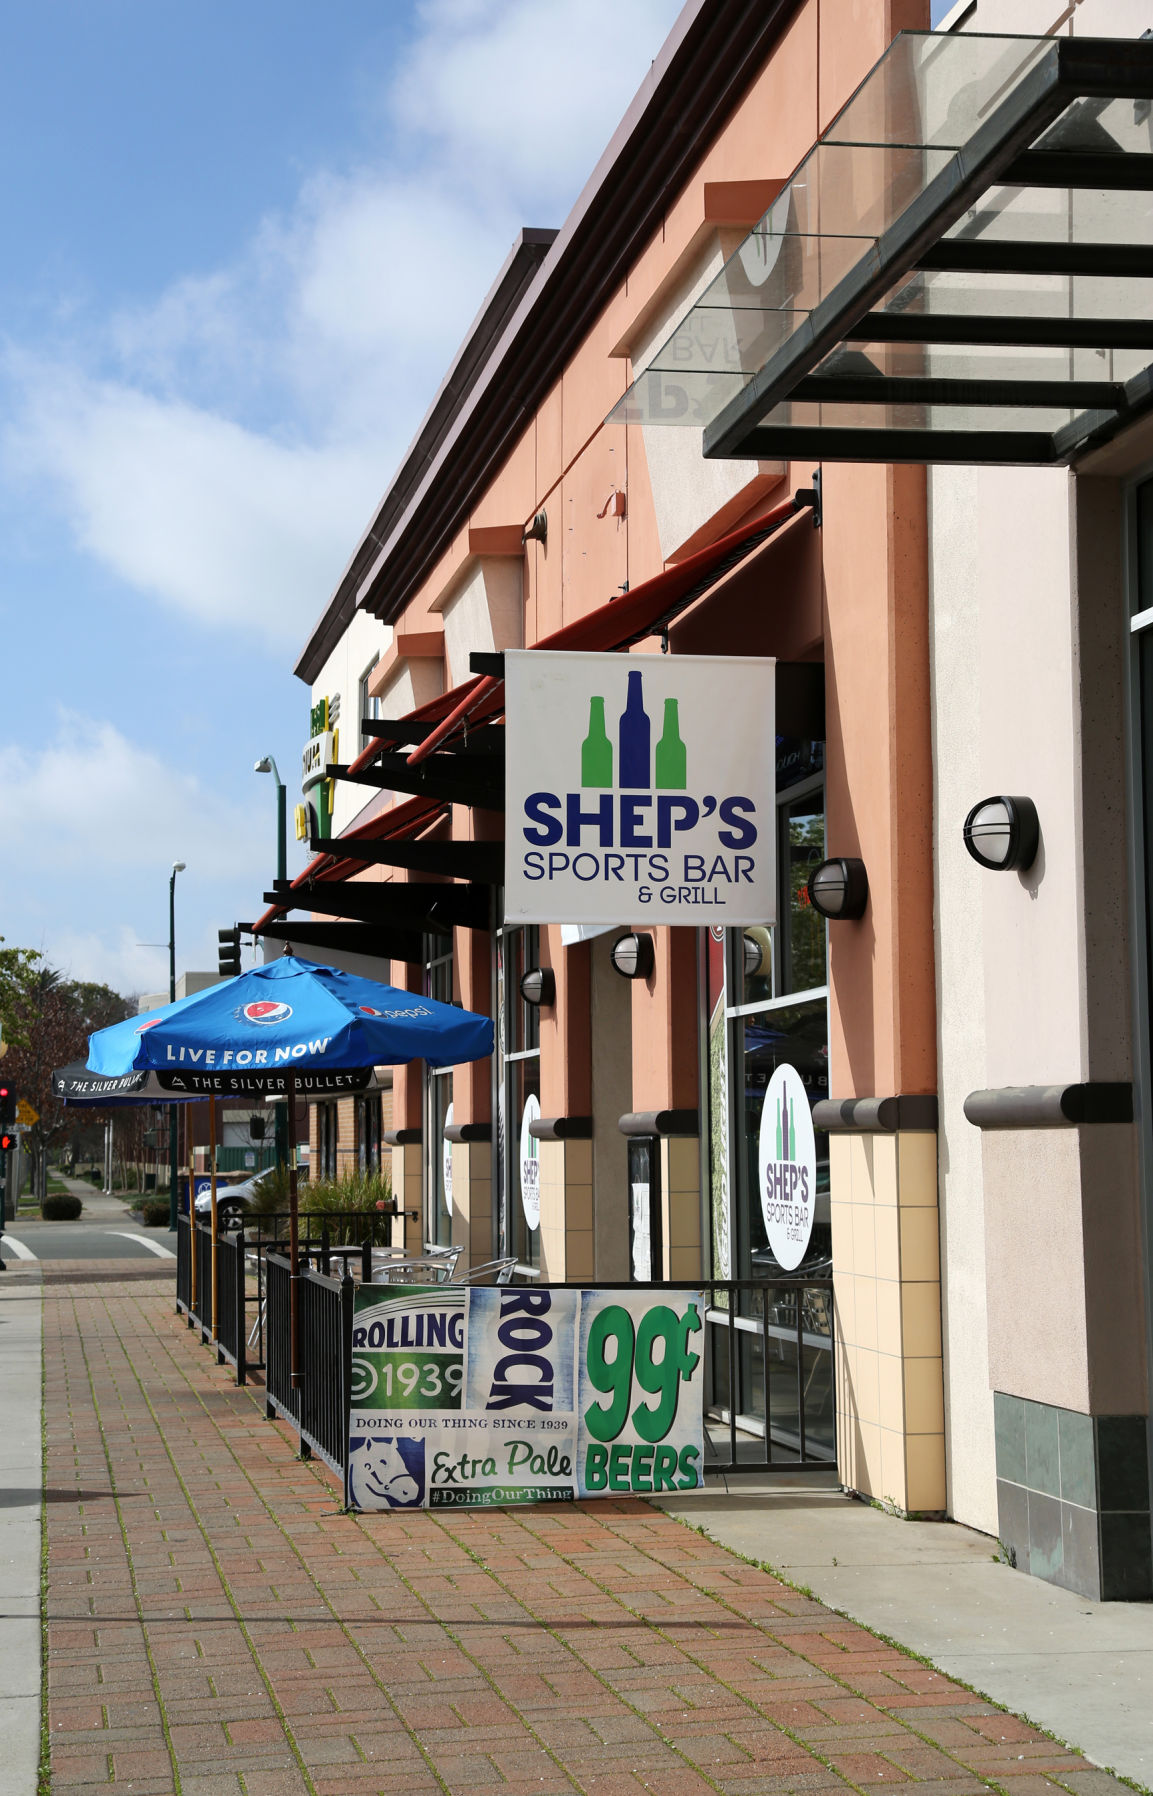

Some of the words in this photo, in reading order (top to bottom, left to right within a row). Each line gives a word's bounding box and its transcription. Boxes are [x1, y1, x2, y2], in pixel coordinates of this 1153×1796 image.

[522, 792, 758, 850] SHEP'S
[522, 851, 670, 883] SPORTS
[683, 854, 756, 884] BAR
[638, 886, 653, 904] &
[660, 886, 726, 905] GRILL
[384, 1005, 434, 1019] pepsi
[166, 1044, 216, 1064] LIVE
[223, 1050, 268, 1065] FOR
[274, 1037, 329, 1062] NOW
[69, 1080, 89, 1092] THE
[90, 1079, 118, 1092] SILVER
[192, 1077, 222, 1089] THE
[230, 1077, 286, 1090] SILVER
[294, 1075, 353, 1089] BULLET
[766, 1163, 809, 1203] SHEP'S
[766, 1202, 793, 1226] SPORTS
[794, 1206, 809, 1228] BAR
[352, 1312, 465, 1349] ROLLING
[485, 1288, 554, 1412] ROCK
[584, 1303, 702, 1443] 99¢
[356, 1417, 404, 1429] DOING
[408, 1418, 438, 1429] OUR
[441, 1418, 488, 1429] THING
[492, 1419, 536, 1430] SINCE
[540, 1420, 568, 1430] 1939
[431, 1451, 498, 1484] Extra
[503, 1440, 573, 1477] Pale
[585, 1444, 700, 1492] BEERS
[432, 1487, 573, 1504] #DoingOurThing
